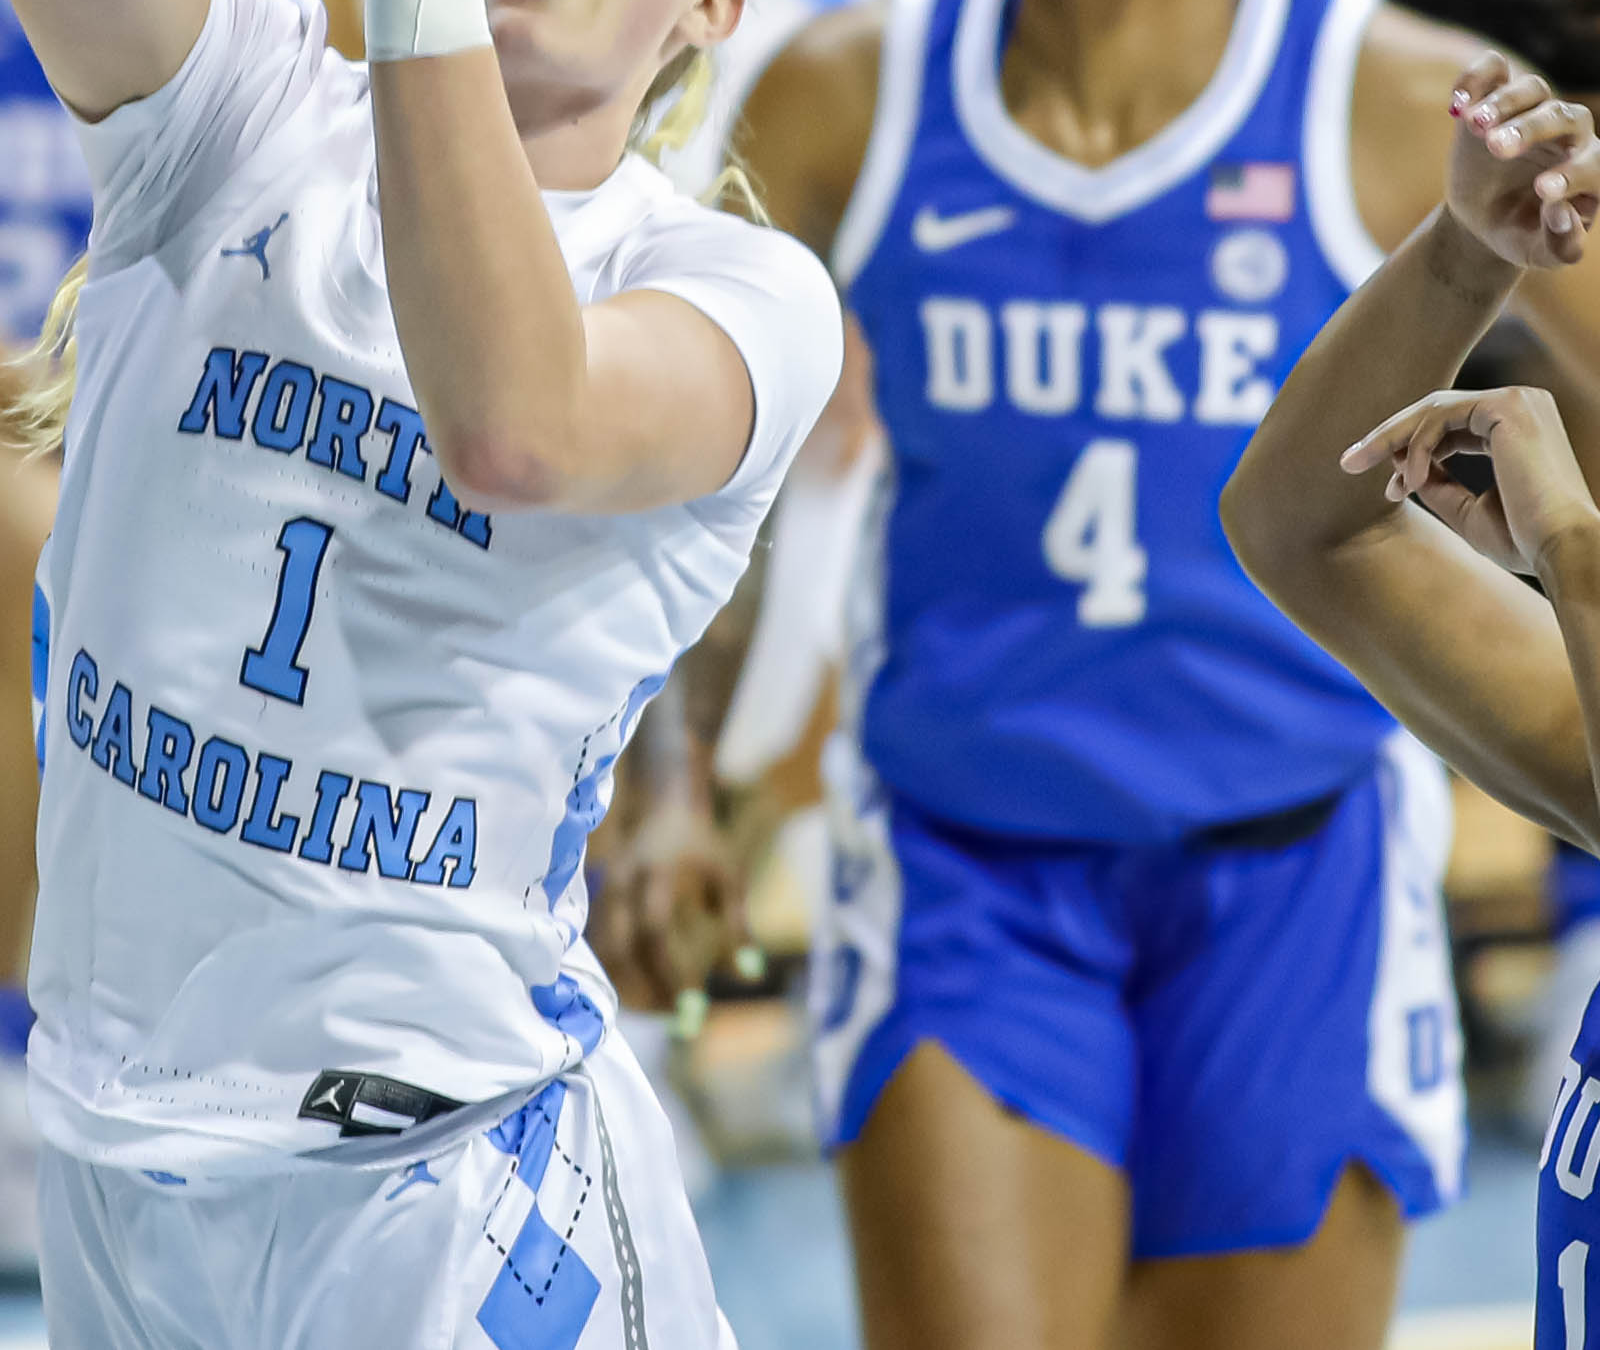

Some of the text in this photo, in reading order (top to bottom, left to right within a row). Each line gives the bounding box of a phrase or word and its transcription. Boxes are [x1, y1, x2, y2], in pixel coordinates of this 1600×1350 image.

[920, 296, 1277, 426] DUKE
[239, 515, 336, 708] 1
[1041, 437, 1148, 629] 4
[66, 648, 478, 889] CAROLINA
